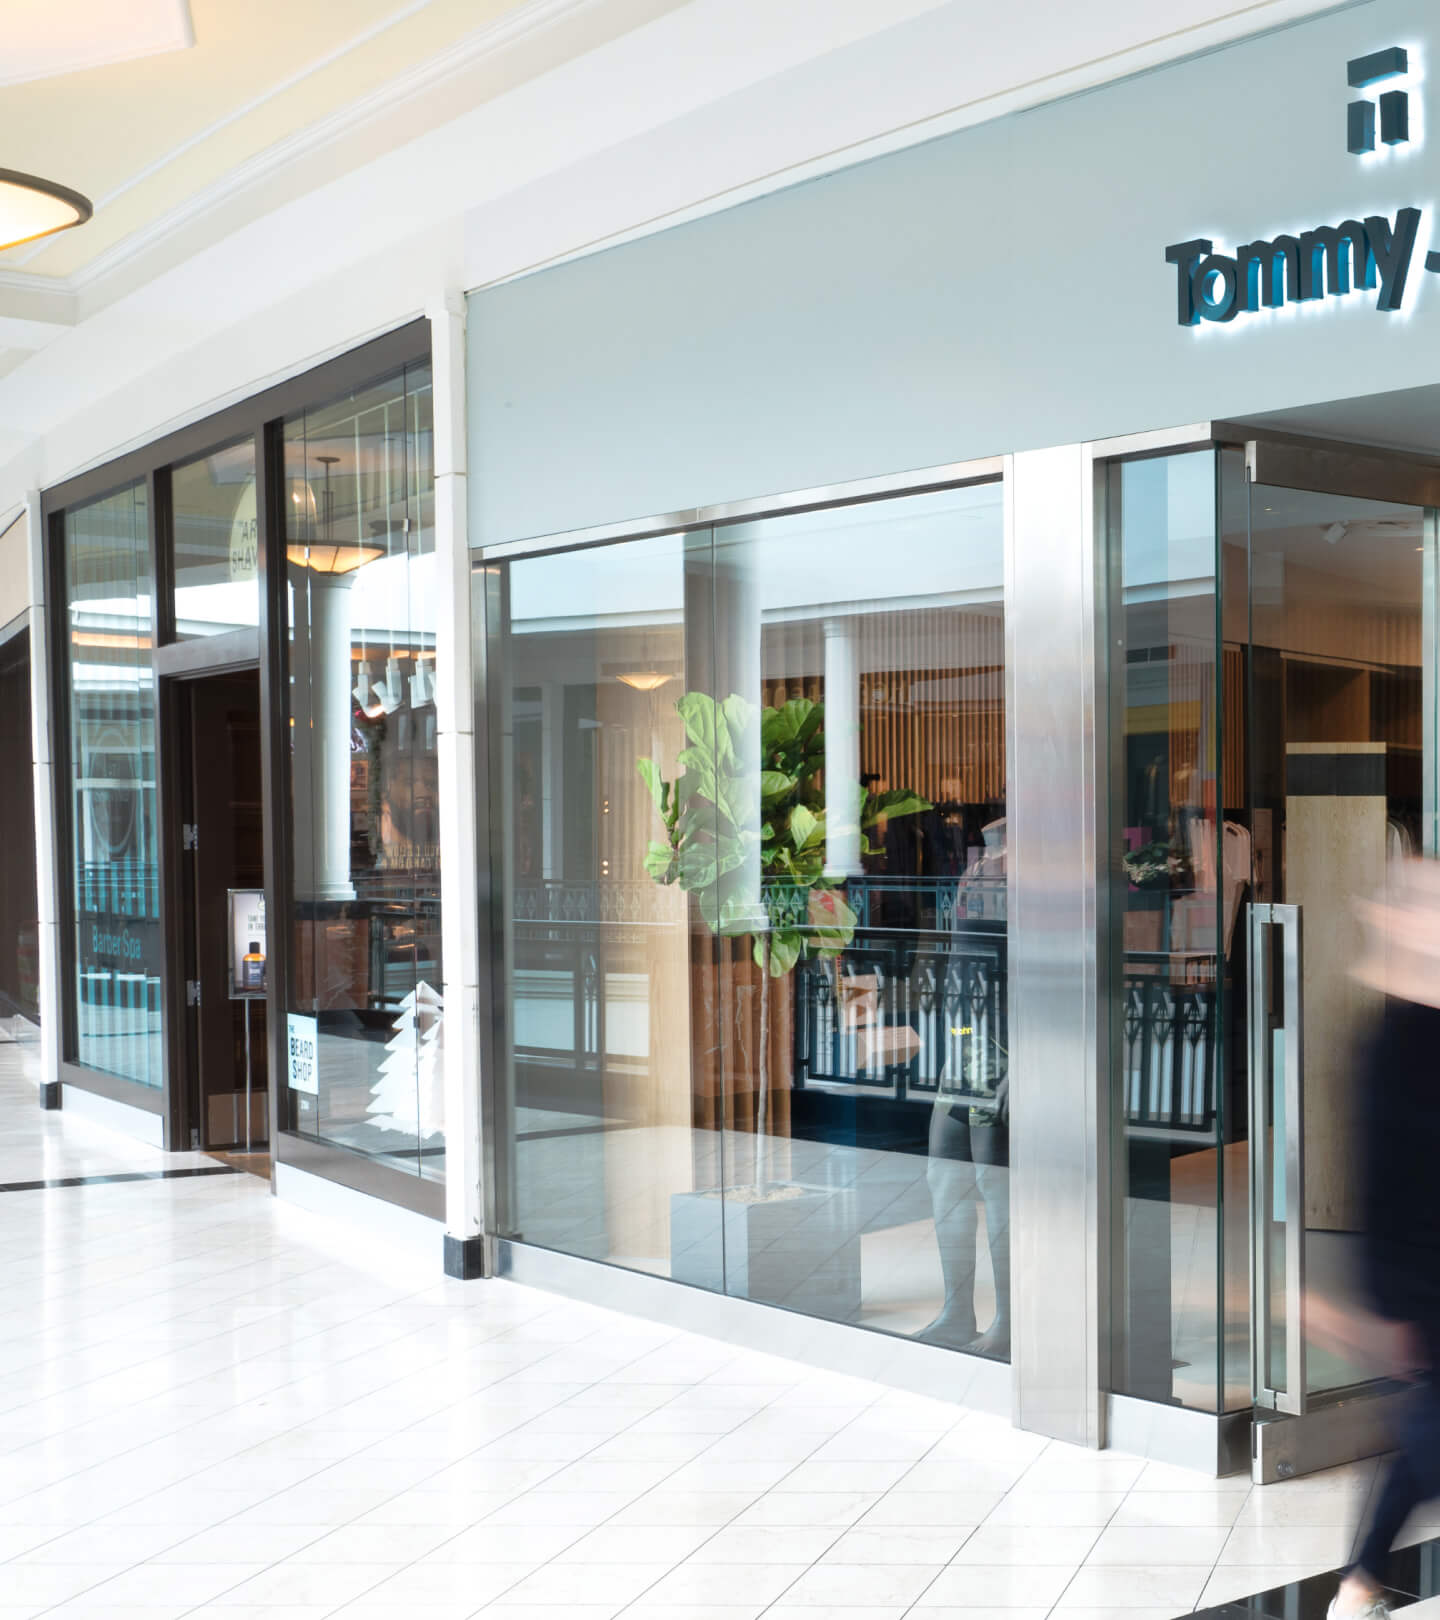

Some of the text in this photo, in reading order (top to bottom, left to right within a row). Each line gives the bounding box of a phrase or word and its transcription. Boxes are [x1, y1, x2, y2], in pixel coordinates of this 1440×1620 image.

[1165, 207, 1421, 327] Tommy
[92, 924, 142, 960] Barber Spa
[290, 1036, 314, 1060] BEARD
[292, 1059, 313, 1081] SHOP
